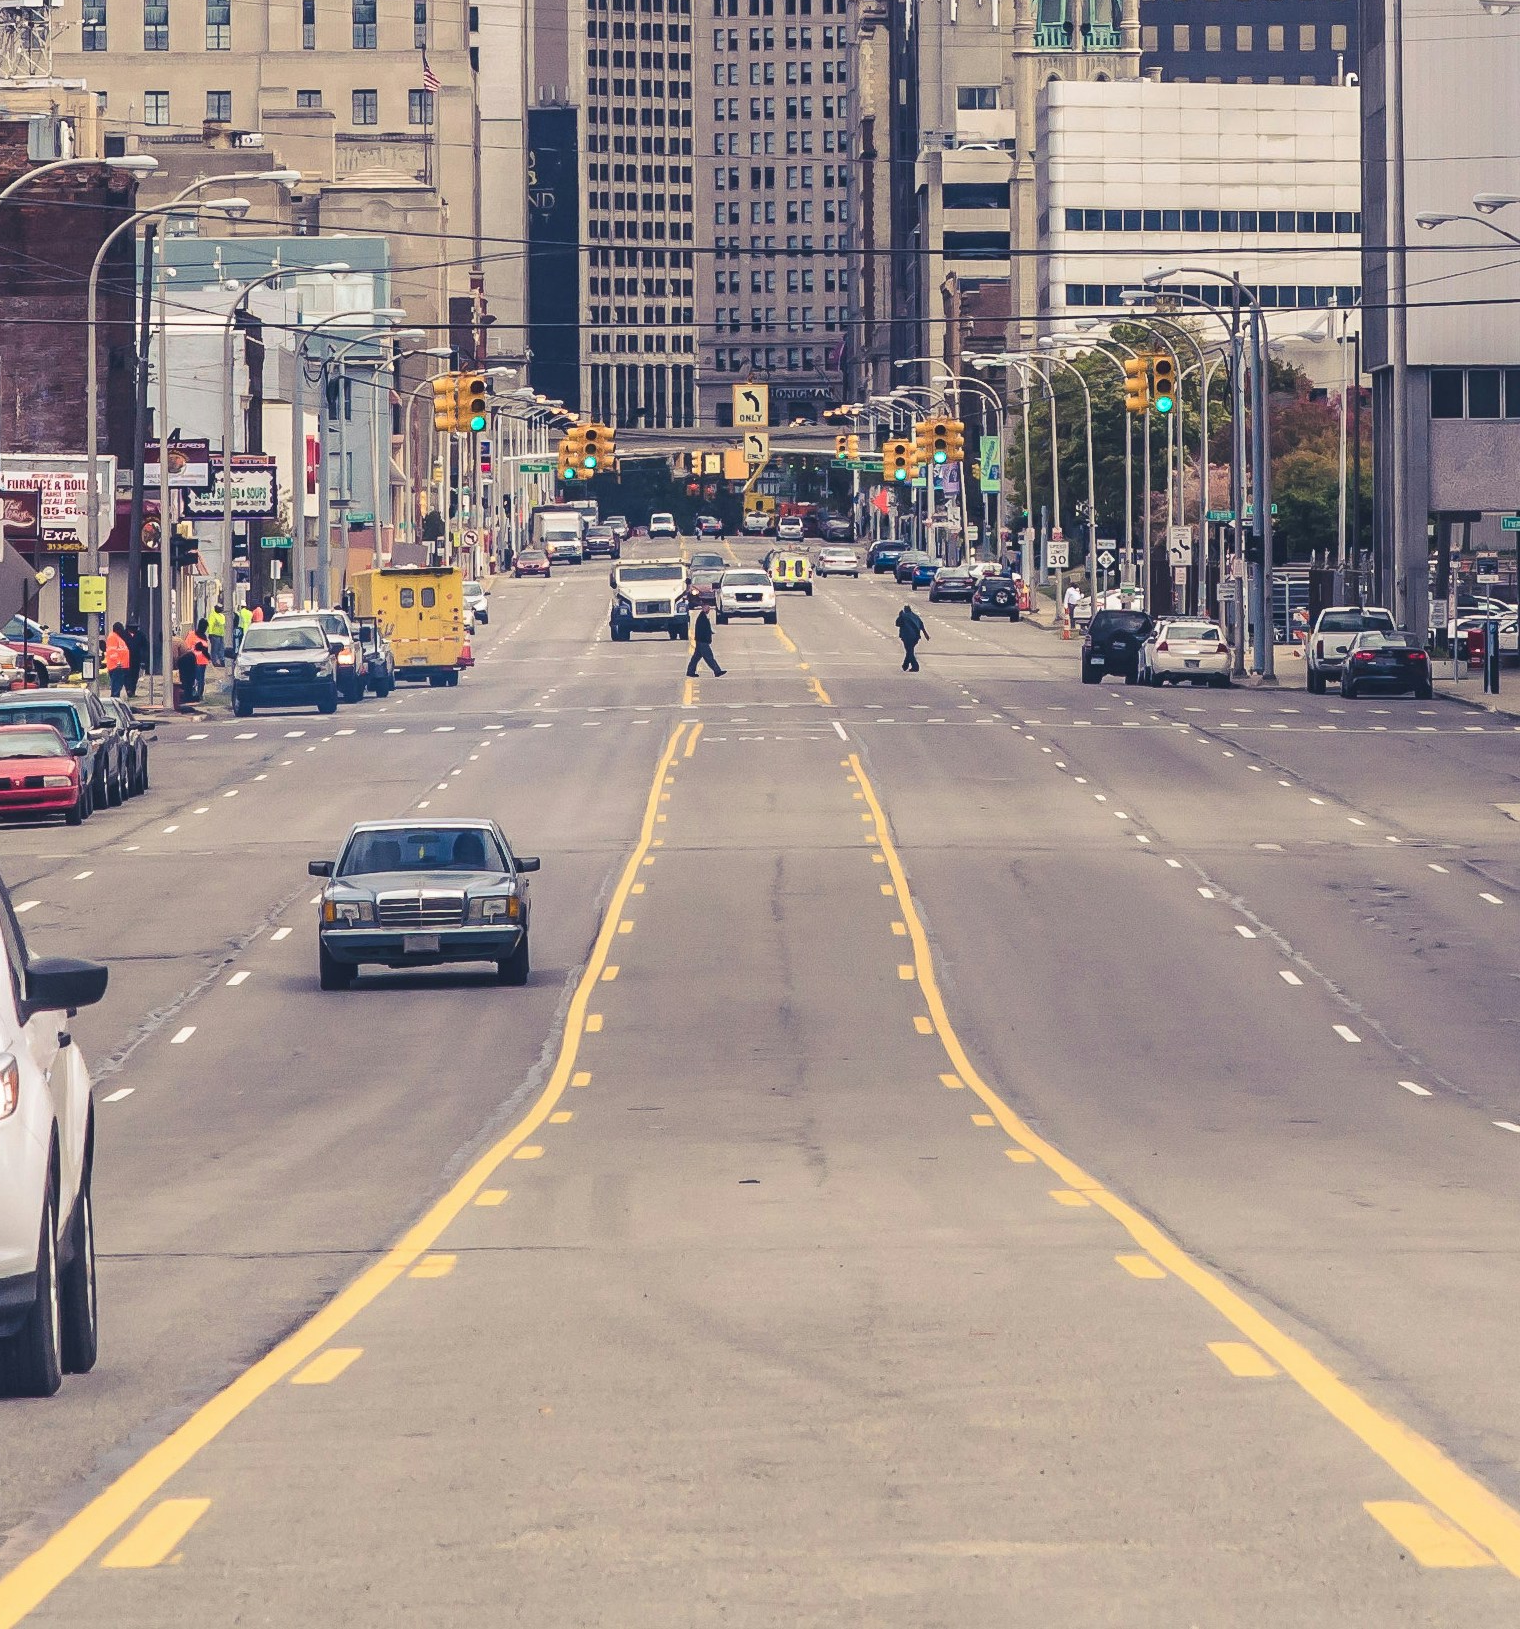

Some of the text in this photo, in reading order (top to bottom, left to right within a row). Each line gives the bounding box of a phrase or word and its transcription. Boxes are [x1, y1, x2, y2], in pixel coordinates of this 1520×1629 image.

[739, 414, 763, 423] ONLY
[7, 479, 53, 491] FURNACE
[54, 480, 61, 491] &
[1050, 555, 1067, 565] 30
